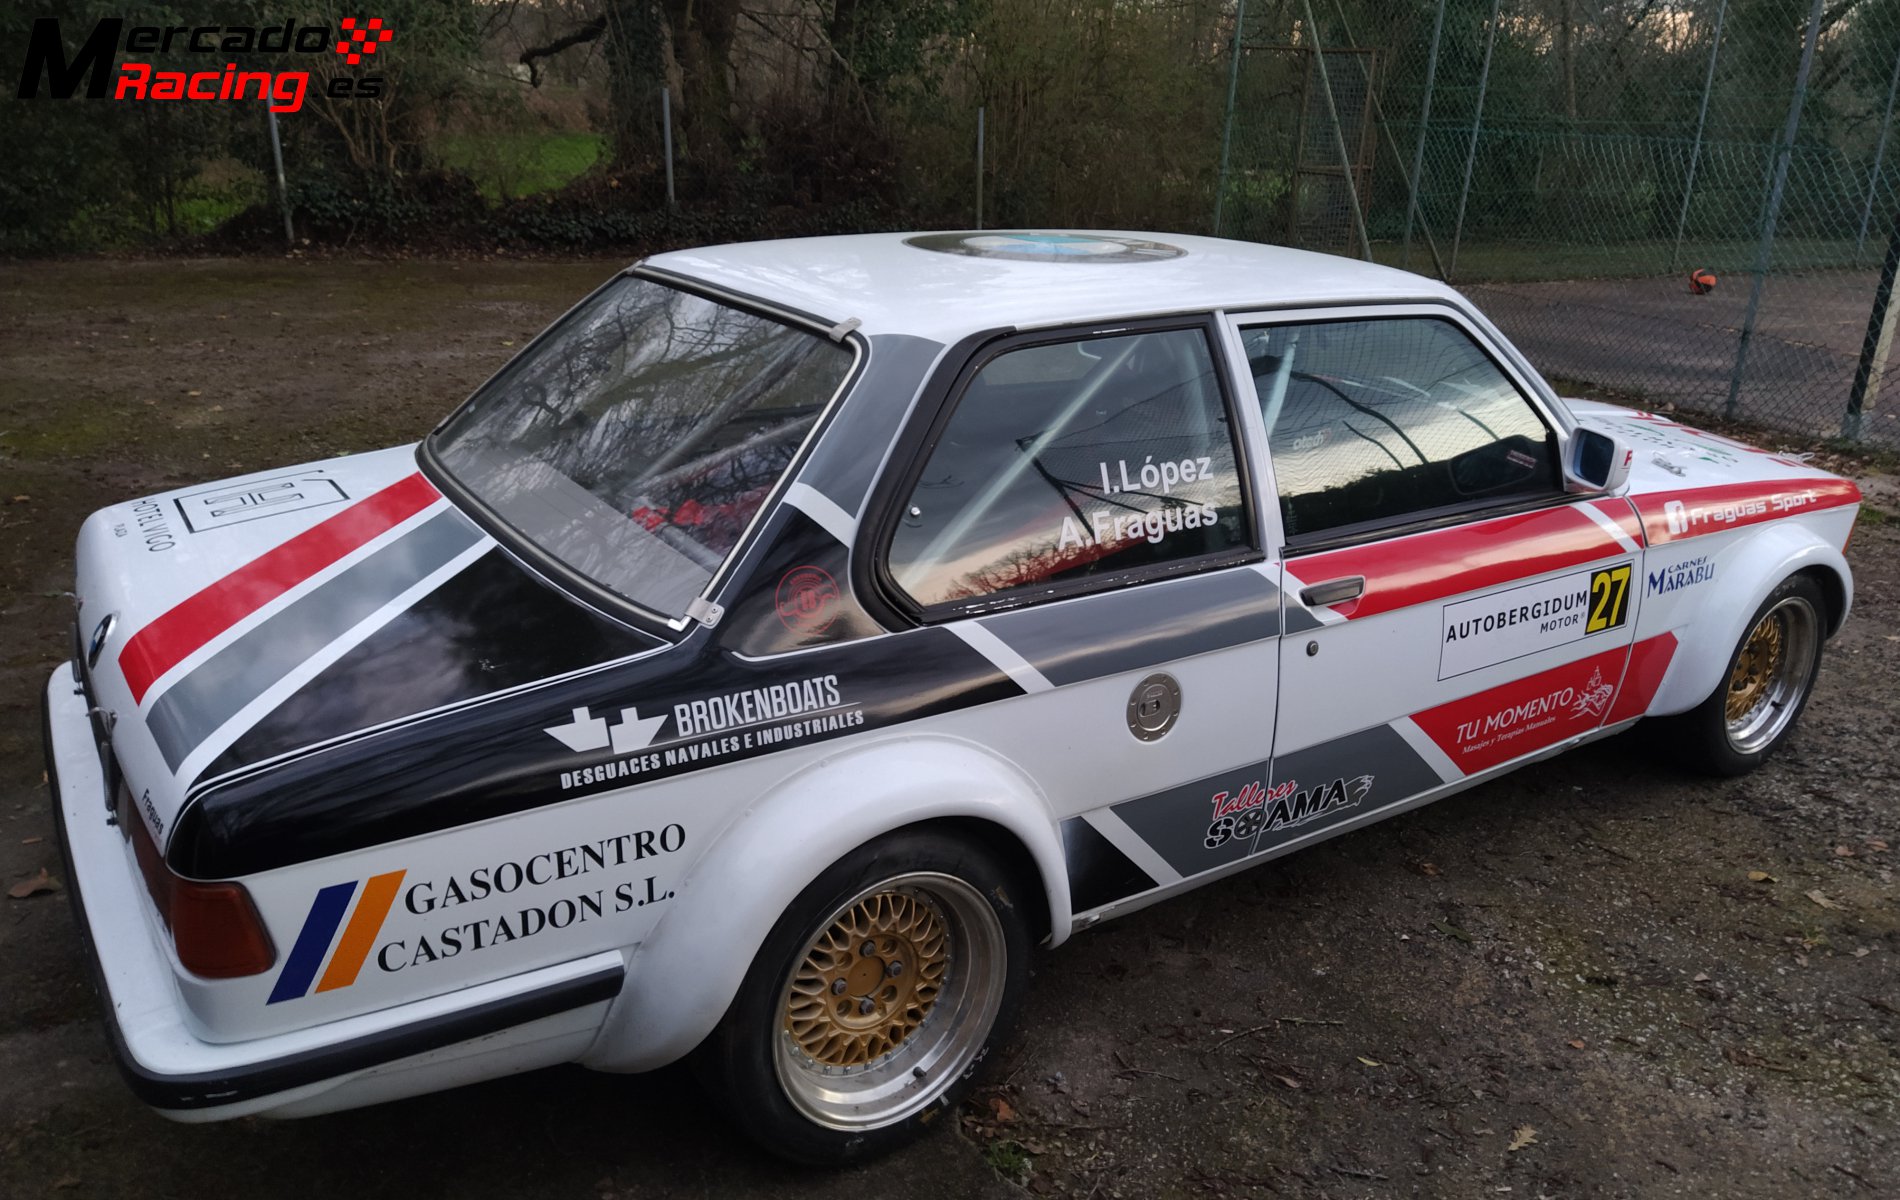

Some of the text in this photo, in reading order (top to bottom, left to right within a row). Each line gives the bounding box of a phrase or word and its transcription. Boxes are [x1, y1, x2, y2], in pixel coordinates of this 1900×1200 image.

[1100, 455, 1214, 495] I.López
[131, 498, 164, 527] HOTEL
[1058, 502, 1218, 551] A.Fraguas
[1691, 500, 1767, 525] Fraguas
[1771, 489, 1817, 511] Sport
[1647, 563, 1715, 599] MARABU
[1667, 555, 1708, 573] CARNES
[1446, 590, 1588, 643] AUTOBERGIDUM
[1586, 566, 1631, 633] 27
[673, 674, 841, 737] BROKENBOATS
[1457, 688, 1574, 744] TU MOMENTO
[560, 709, 864, 790] DESGUACES NAVALES E INDUSTRIALES
[142, 788, 164, 835] Fraguas
[1212, 779, 1298, 821] Talleres
[404, 823, 687, 915] GASOCENTRO
[377, 875, 676, 973] CASTADON S.L.
